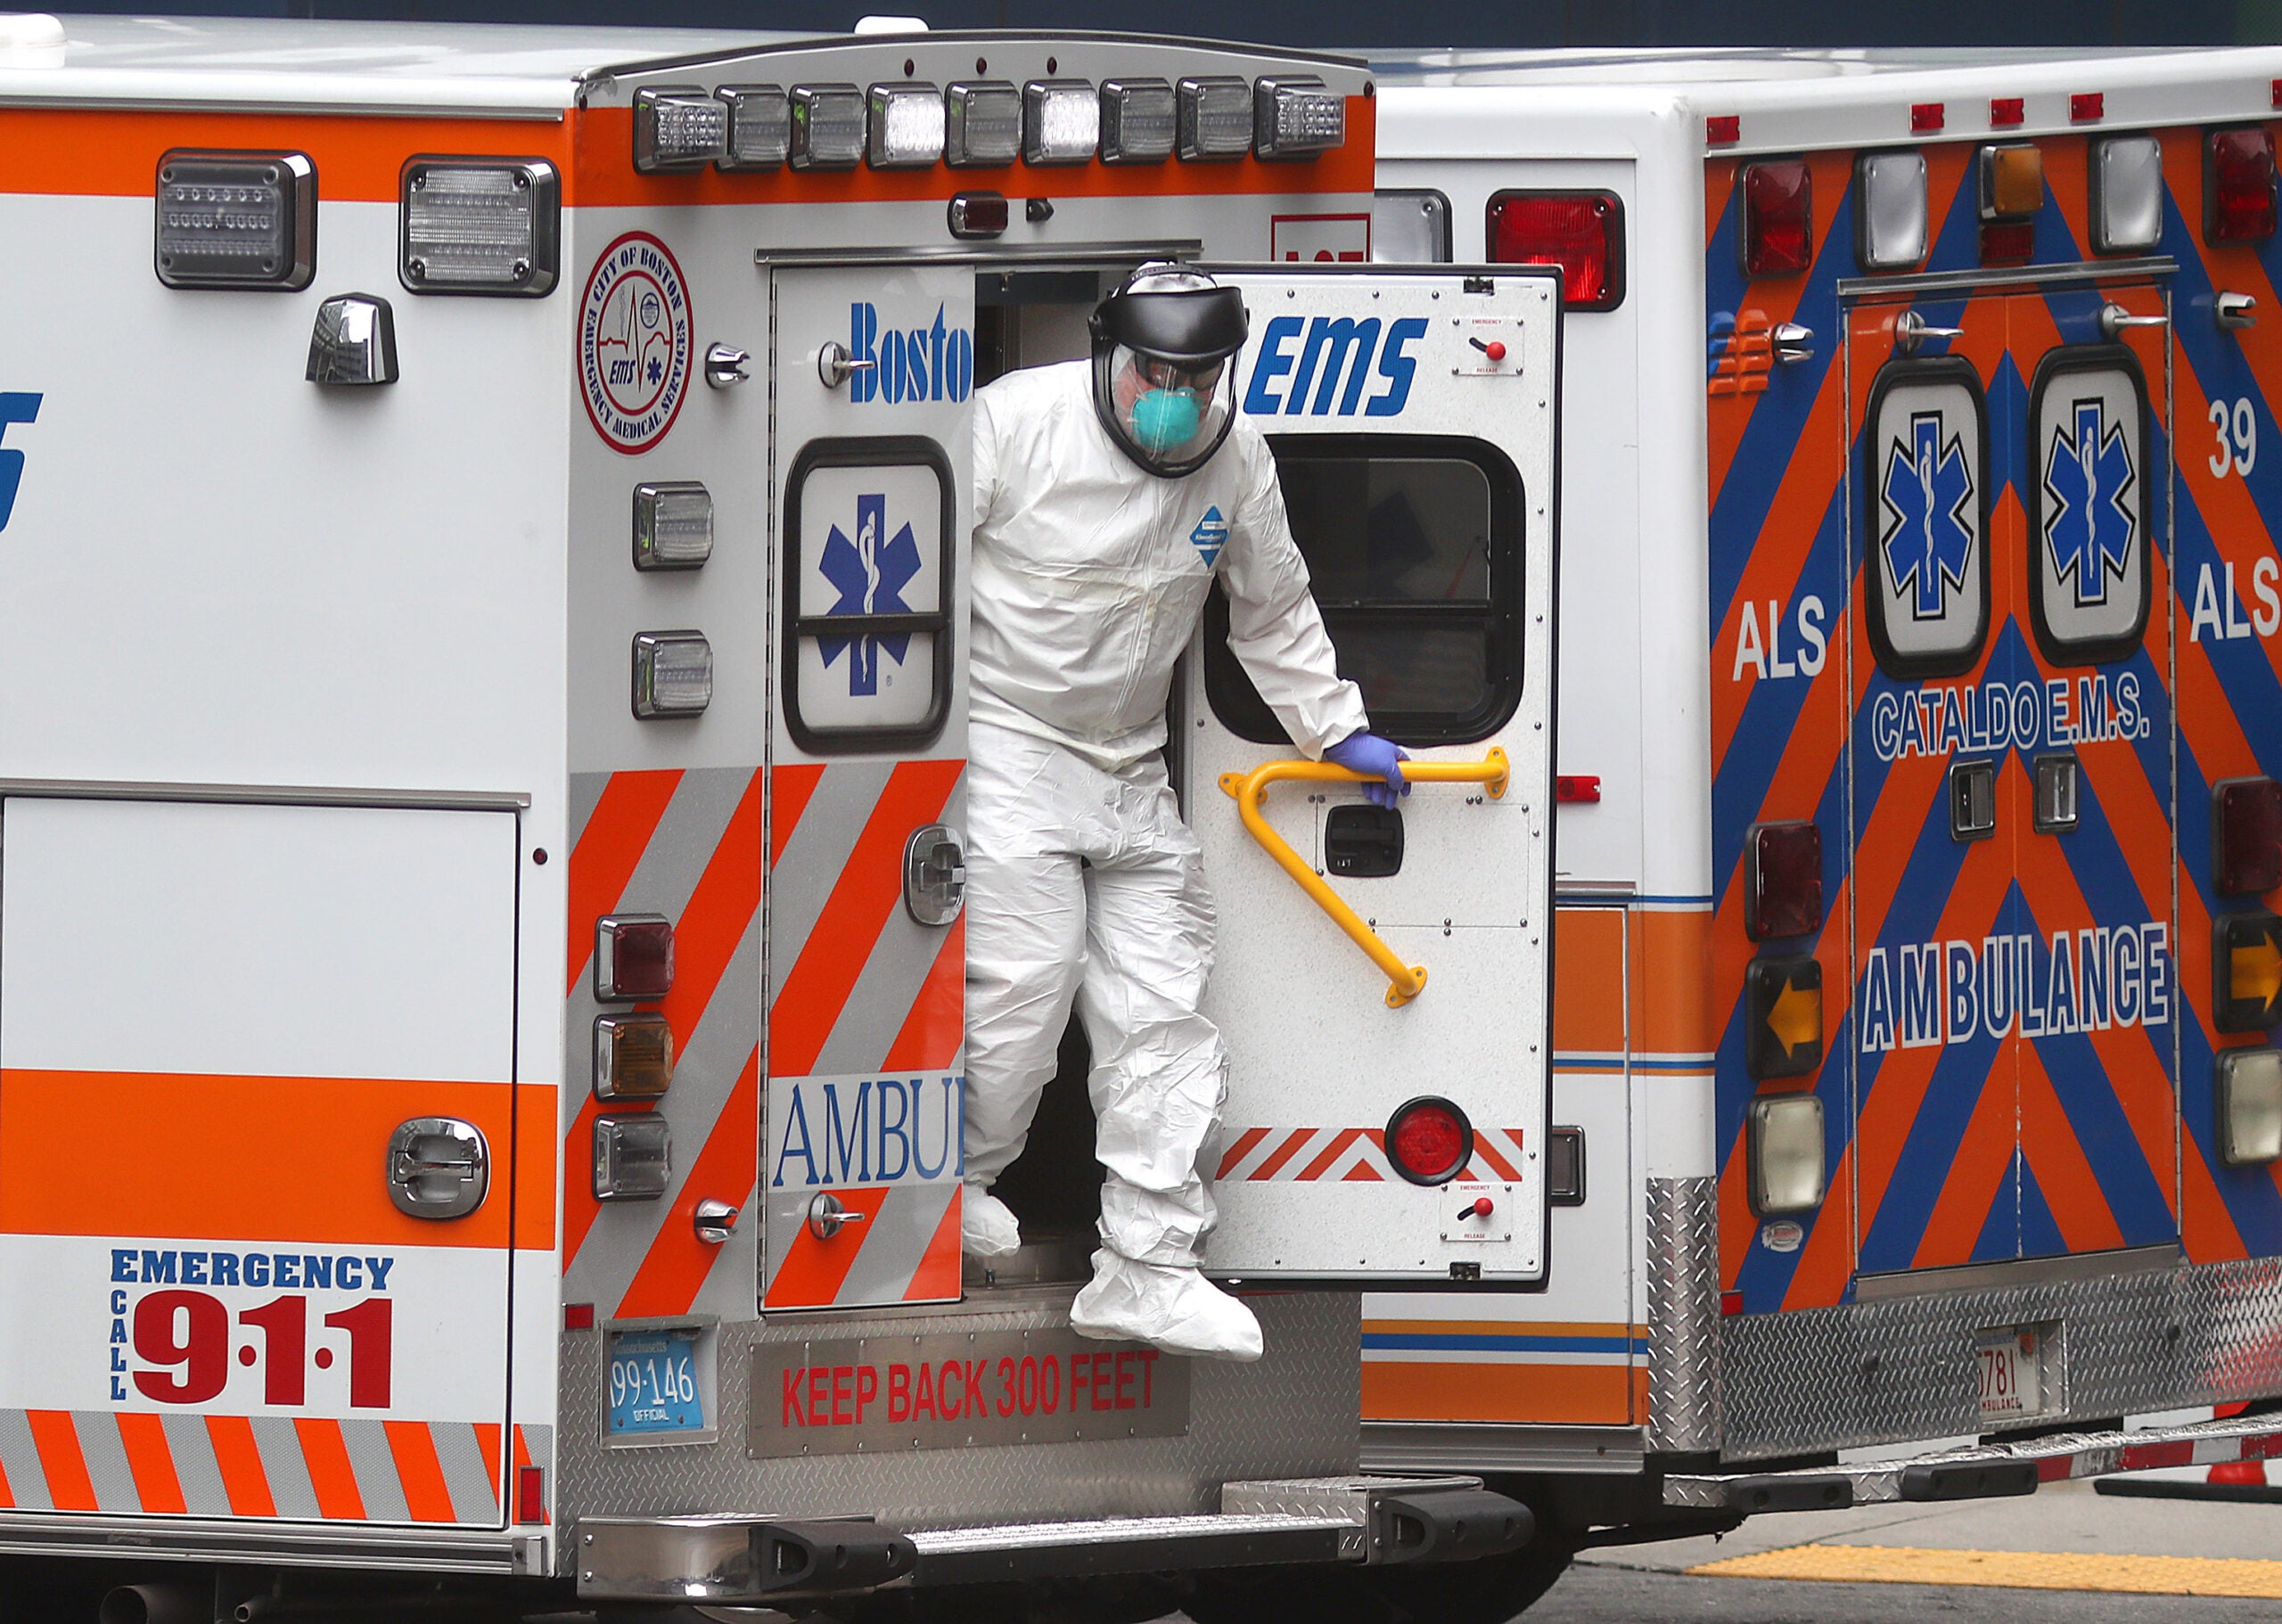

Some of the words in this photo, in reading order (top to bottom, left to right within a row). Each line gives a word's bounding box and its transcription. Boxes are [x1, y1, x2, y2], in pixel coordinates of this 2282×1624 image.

[593, 258, 618, 301] CITY
[620, 247, 636, 267] OF
[640, 247, 682, 312] BOSTON
[585, 308, 613, 424] EMERGENCY
[612, 411, 662, 439] MEDICAL
[661, 319, 685, 414] SERVICES
[609, 359, 636, 384] EMS
[850, 300, 974, 404] Bosto
[1243, 316, 1429, 416] EMS
[2208, 397, 2257, 480] 39
[1732, 595, 1826, 682] ALS
[2190, 556, 2282, 643] ALS
[1872, 680, 2040, 762] CATALDO
[2047, 671, 2150, 748] E.M.S.
[1861, 921, 2169, 1054] AMBULANCE
[110, 1249, 394, 1291] EMERGENCY
[110, 1290, 127, 1400] CALL
[782, 1365, 877, 1426] KEEP
[889, 1358, 989, 1422] BACK
[997, 1352, 1062, 1416] 300
[1070, 1349, 1159, 1412] FEET
[633, 1408, 669, 1422] OFFICIAL
[1980, 1397, 2020, 1412] MBULANCE
